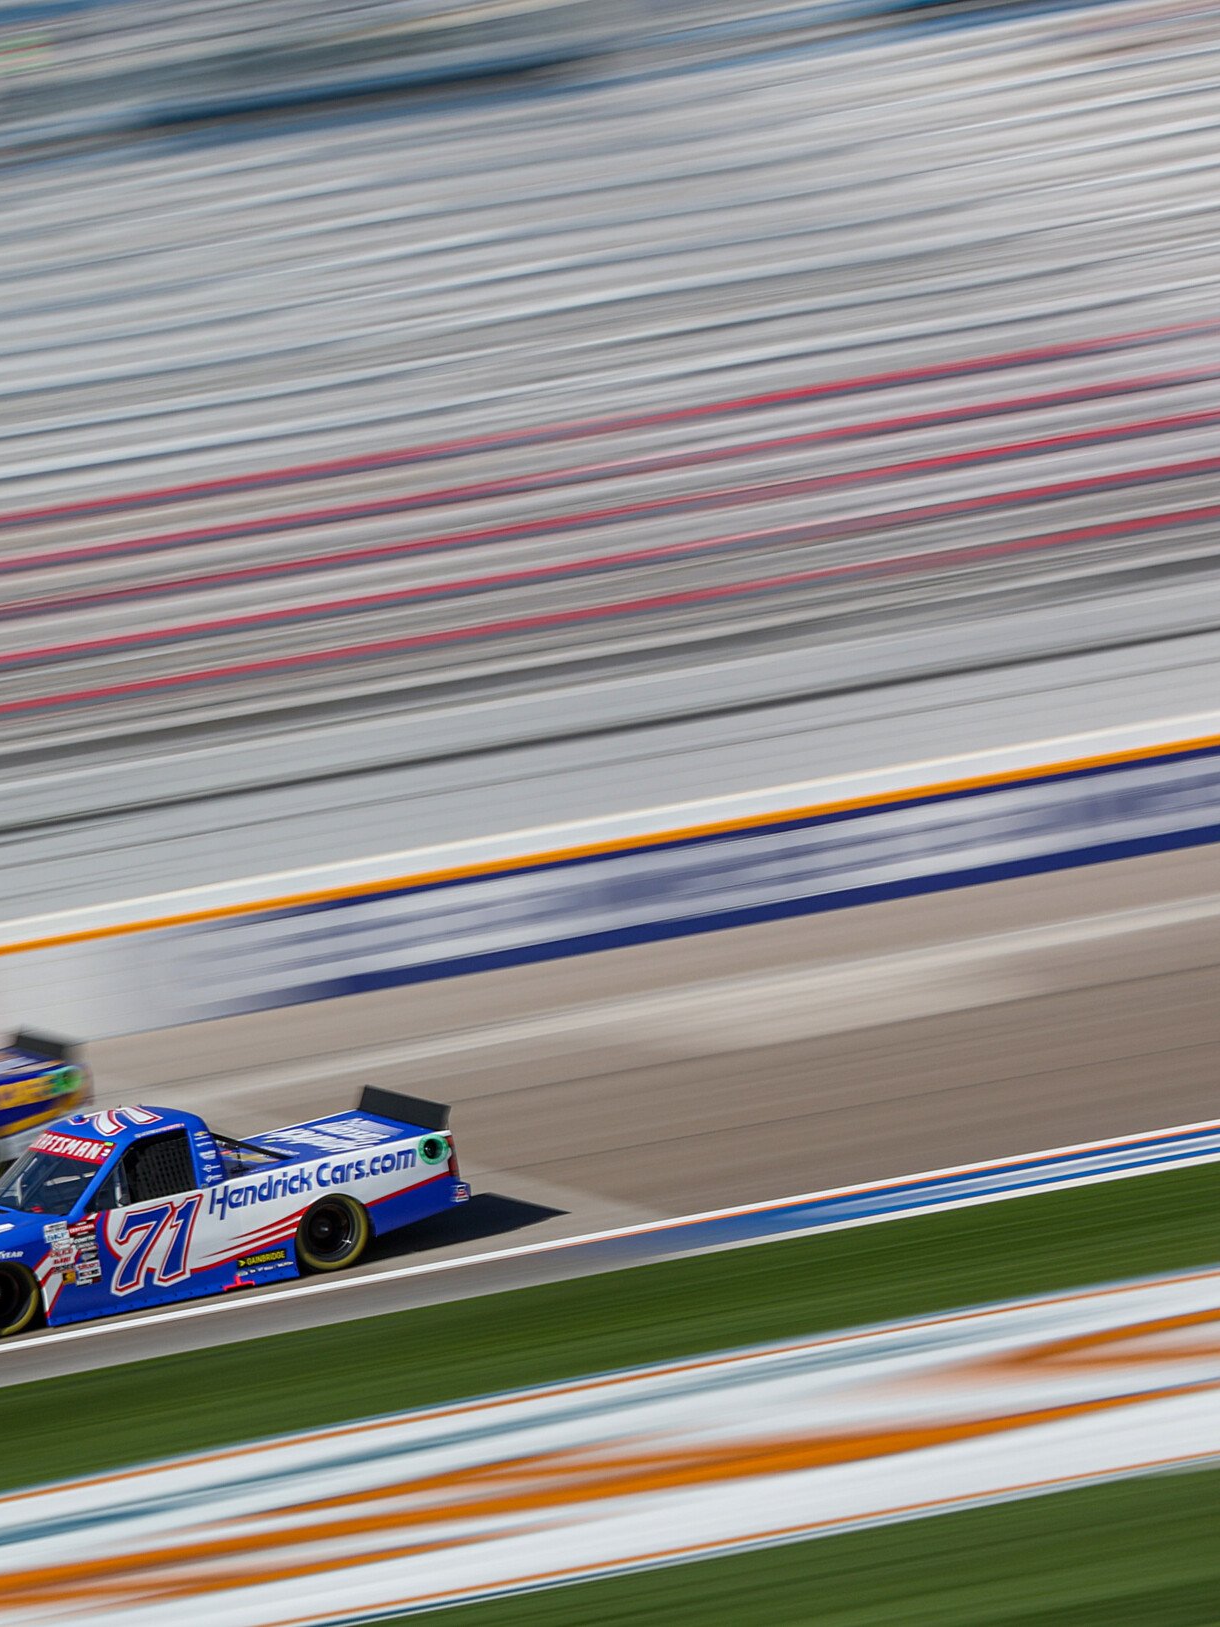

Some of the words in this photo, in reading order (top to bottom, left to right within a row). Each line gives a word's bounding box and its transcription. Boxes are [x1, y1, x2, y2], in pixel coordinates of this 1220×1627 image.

[209, 1168, 313, 1220] Hendrick
[316, 1148, 417, 1187] Cars.com
[112, 1194, 204, 1297] 71
[246, 1250, 286, 1266] GAINBRIDGE
